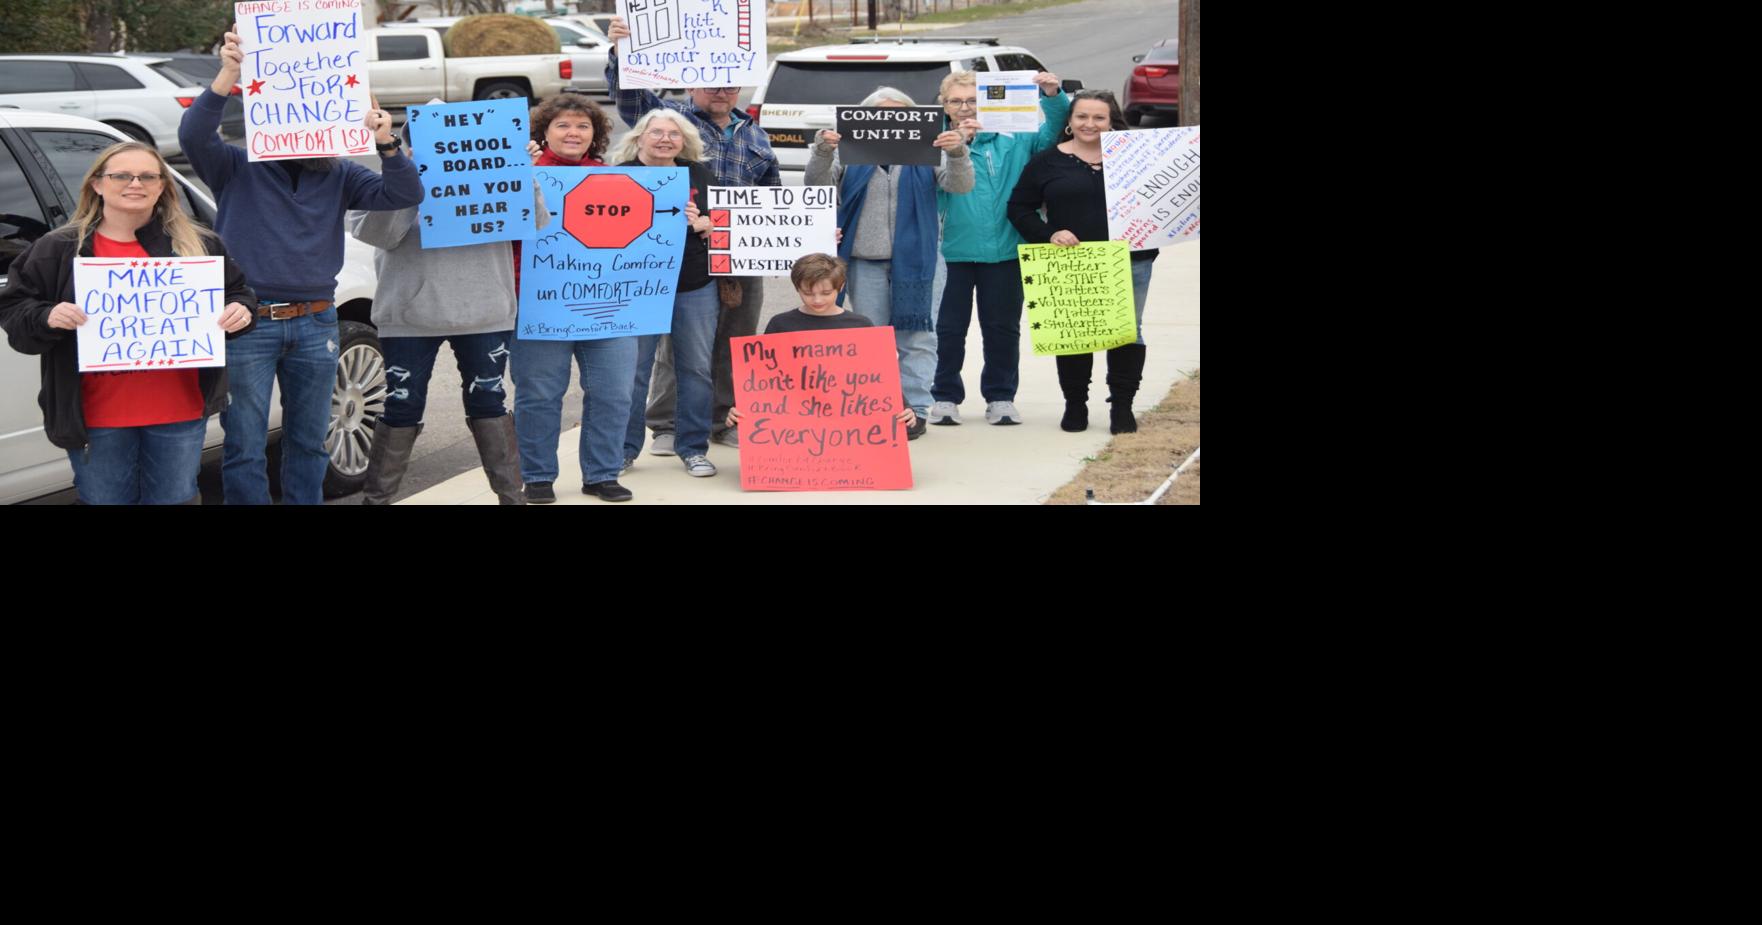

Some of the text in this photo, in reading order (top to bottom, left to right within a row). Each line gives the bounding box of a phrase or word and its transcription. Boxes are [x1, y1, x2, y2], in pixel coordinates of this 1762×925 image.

[238, 0, 359, 14] CHANGE IS COMING
[255, 12, 356, 44] Forward
[684, 12, 714, 28] hit
[246, 48, 360, 90] Together
[628, 51, 756, 72] on your way
[681, 65, 740, 84] OUT
[299, 74, 344, 100] FOR
[250, 100, 363, 126] CHANGE
[841, 110, 938, 122] COMFORT
[252, 126, 370, 155] COMFORT ISD
[852, 129, 921, 140] UNITE
[434, 137, 512, 154] SCHOOL
[1103, 132, 1131, 158] ENOUGH
[444, 156, 526, 172] BOARD...
[1137, 148, 1200, 200] ENOUGH
[431, 180, 522, 198] CAN YOU
[710, 187, 833, 208] TIME TO GO!
[456, 201, 508, 216] HEAR
[584, 204, 631, 216] STOP
[1152, 208, 1170, 221] IS
[471, 220, 504, 234] US?
[737, 214, 814, 226] MONROE
[738, 236, 802, 248] ADAMS
[1025, 246, 1106, 260] TEACHERS
[533, 253, 676, 280] Making Comfort
[1047, 260, 1106, 273] Matter
[108, 268, 184, 288] MAKE
[1032, 271, 1109, 285] The STAFF
[1050, 284, 1110, 296] Matters
[84, 288, 224, 315] COMFORT
[1038, 296, 1114, 308] Volunteers
[1054, 307, 1110, 318] Matter
[100, 316, 199, 339] GREAT
[1044, 317, 1107, 328] Students
[1060, 328, 1119, 338] Matter
[102, 332, 214, 362] AGAIN
[743, 340, 858, 370] My mama
[742, 364, 882, 396] don't like you
[750, 390, 892, 418] and she likes
[748, 414, 898, 456] Everyone!
